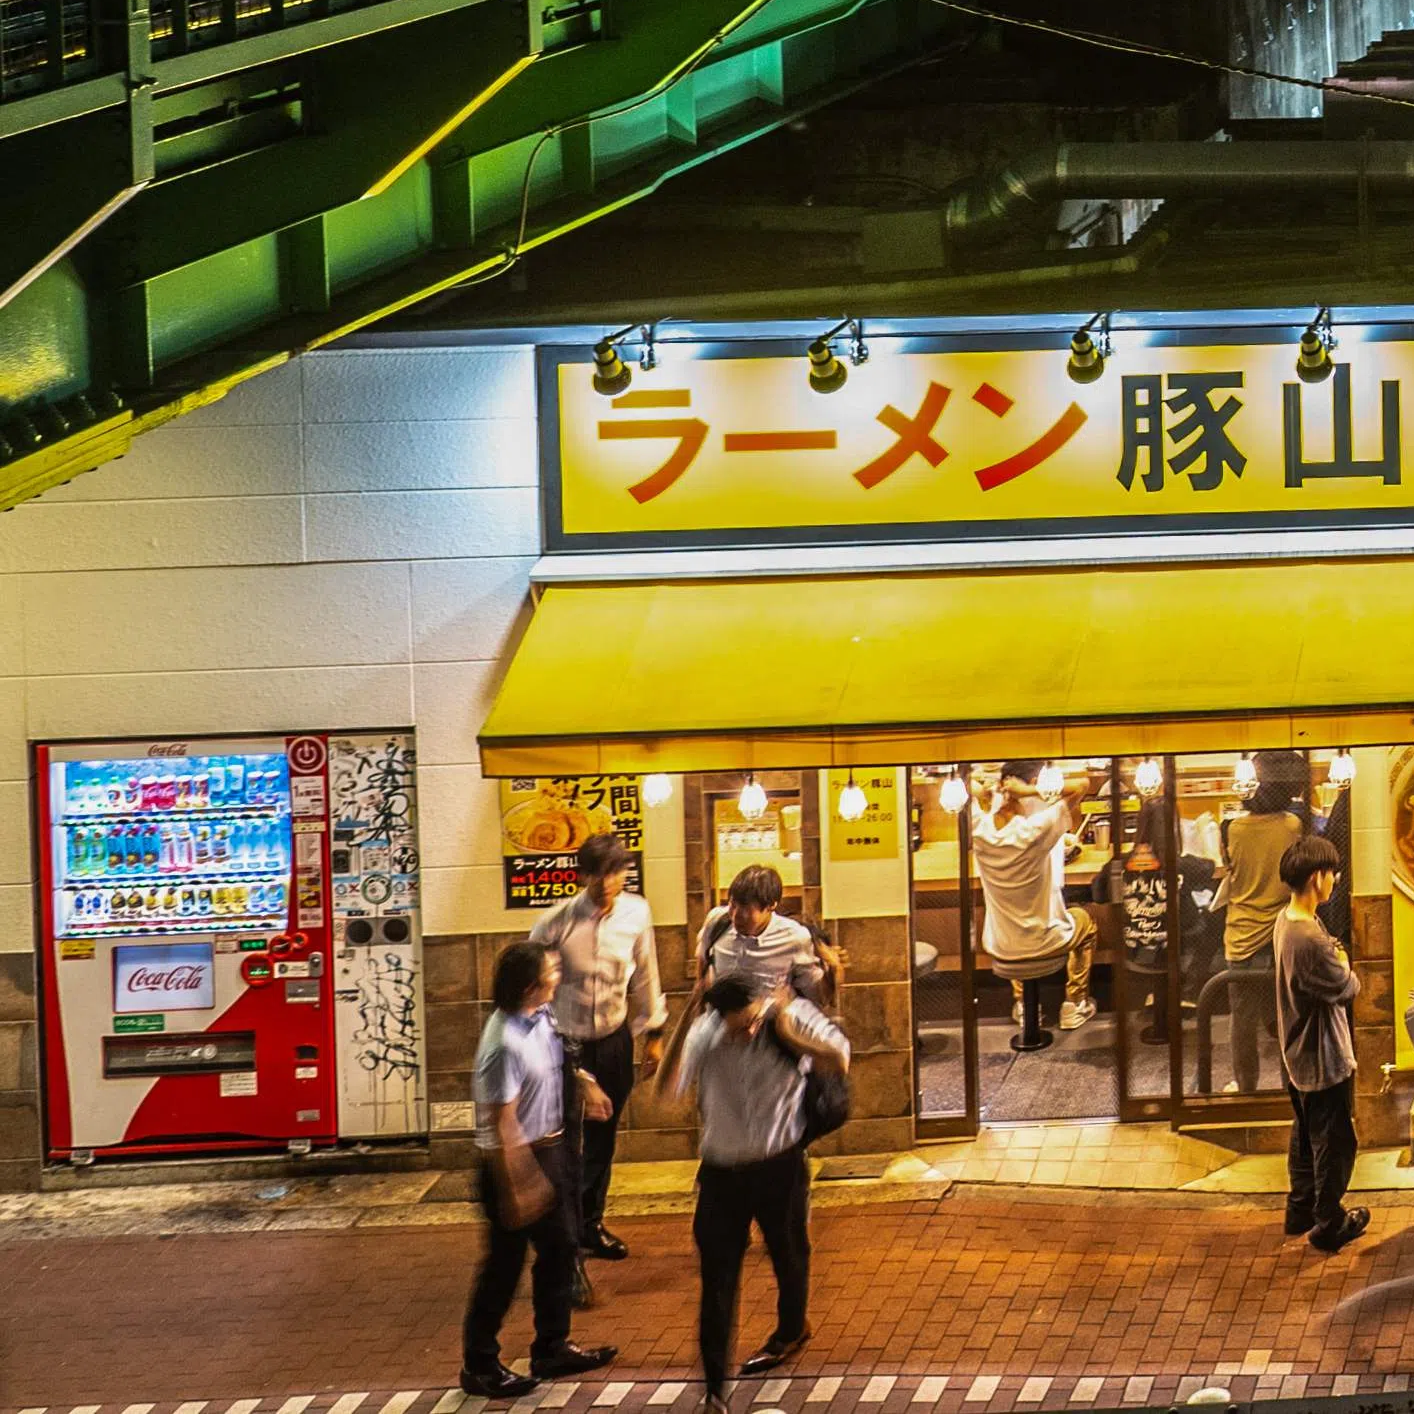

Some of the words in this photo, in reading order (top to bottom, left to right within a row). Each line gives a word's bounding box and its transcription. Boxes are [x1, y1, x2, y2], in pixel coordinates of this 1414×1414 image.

[598, 364, 1401, 504] ラーメン豚山
[147, 744, 188, 757] Coca-Cola
[609, 775, 642, 849] 間帯
[127, 965, 208, 993] Coca-Cola
